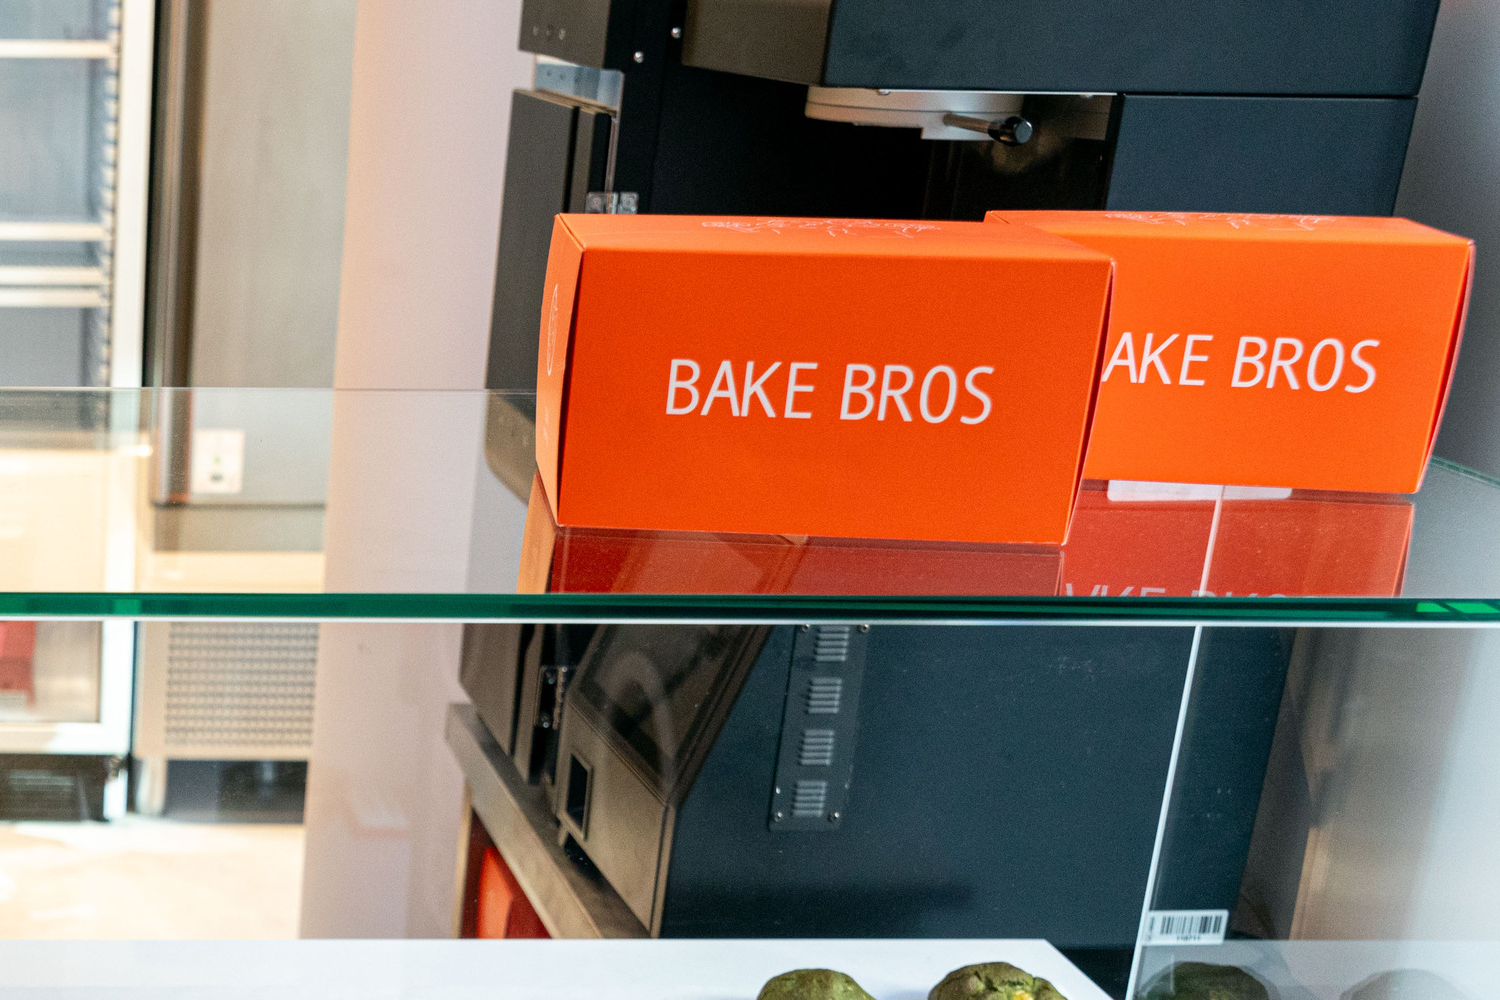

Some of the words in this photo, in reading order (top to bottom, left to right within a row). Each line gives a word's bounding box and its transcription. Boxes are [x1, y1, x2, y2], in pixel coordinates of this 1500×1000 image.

[665, 358, 819, 419] BAKE
[839, 363, 995, 425] BROS
[1100, 331, 1214, 386] AKE
[1230, 335, 1381, 394] BROS
